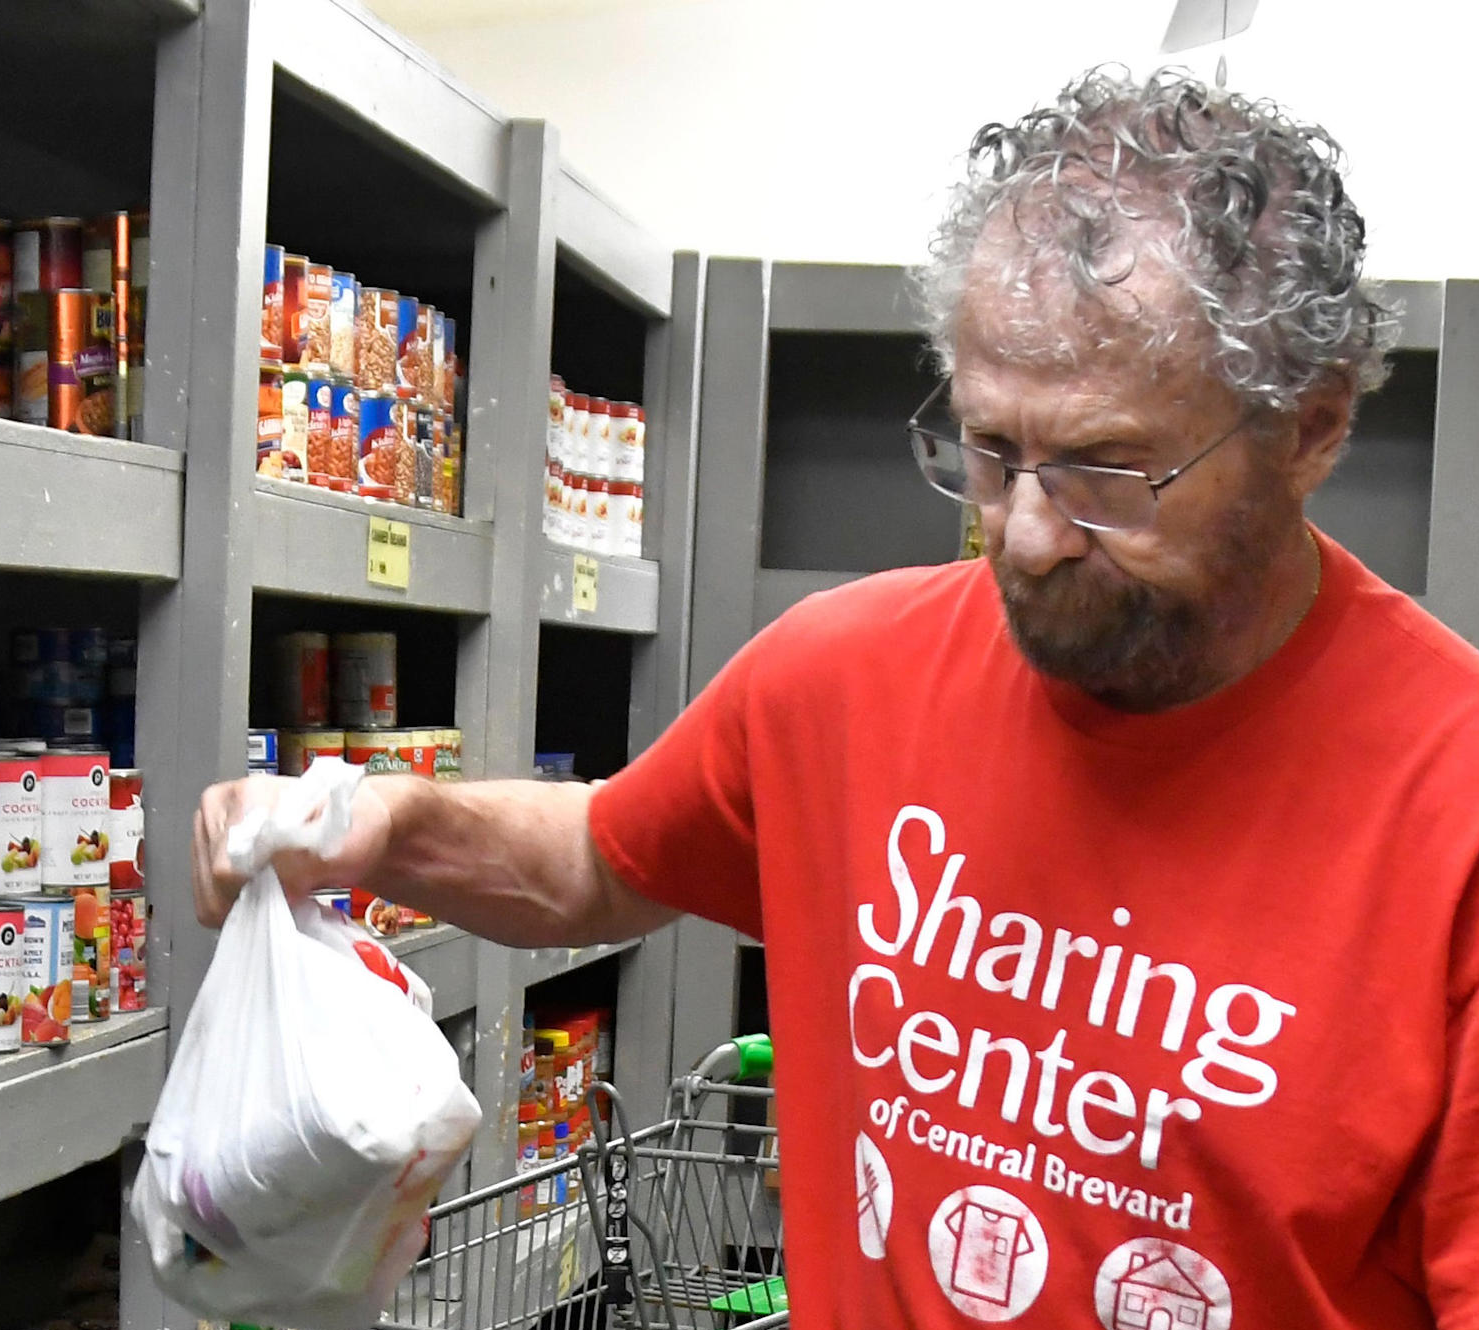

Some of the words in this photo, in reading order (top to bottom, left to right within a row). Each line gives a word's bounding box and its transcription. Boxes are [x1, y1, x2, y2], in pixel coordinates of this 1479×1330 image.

[857, 804, 1298, 1107] Sharing
[848, 962, 1203, 1170] Center
[869, 1094, 910, 1140] of
[907, 1107, 1037, 1183] Central
[1043, 1154, 1194, 1231] Brevard
